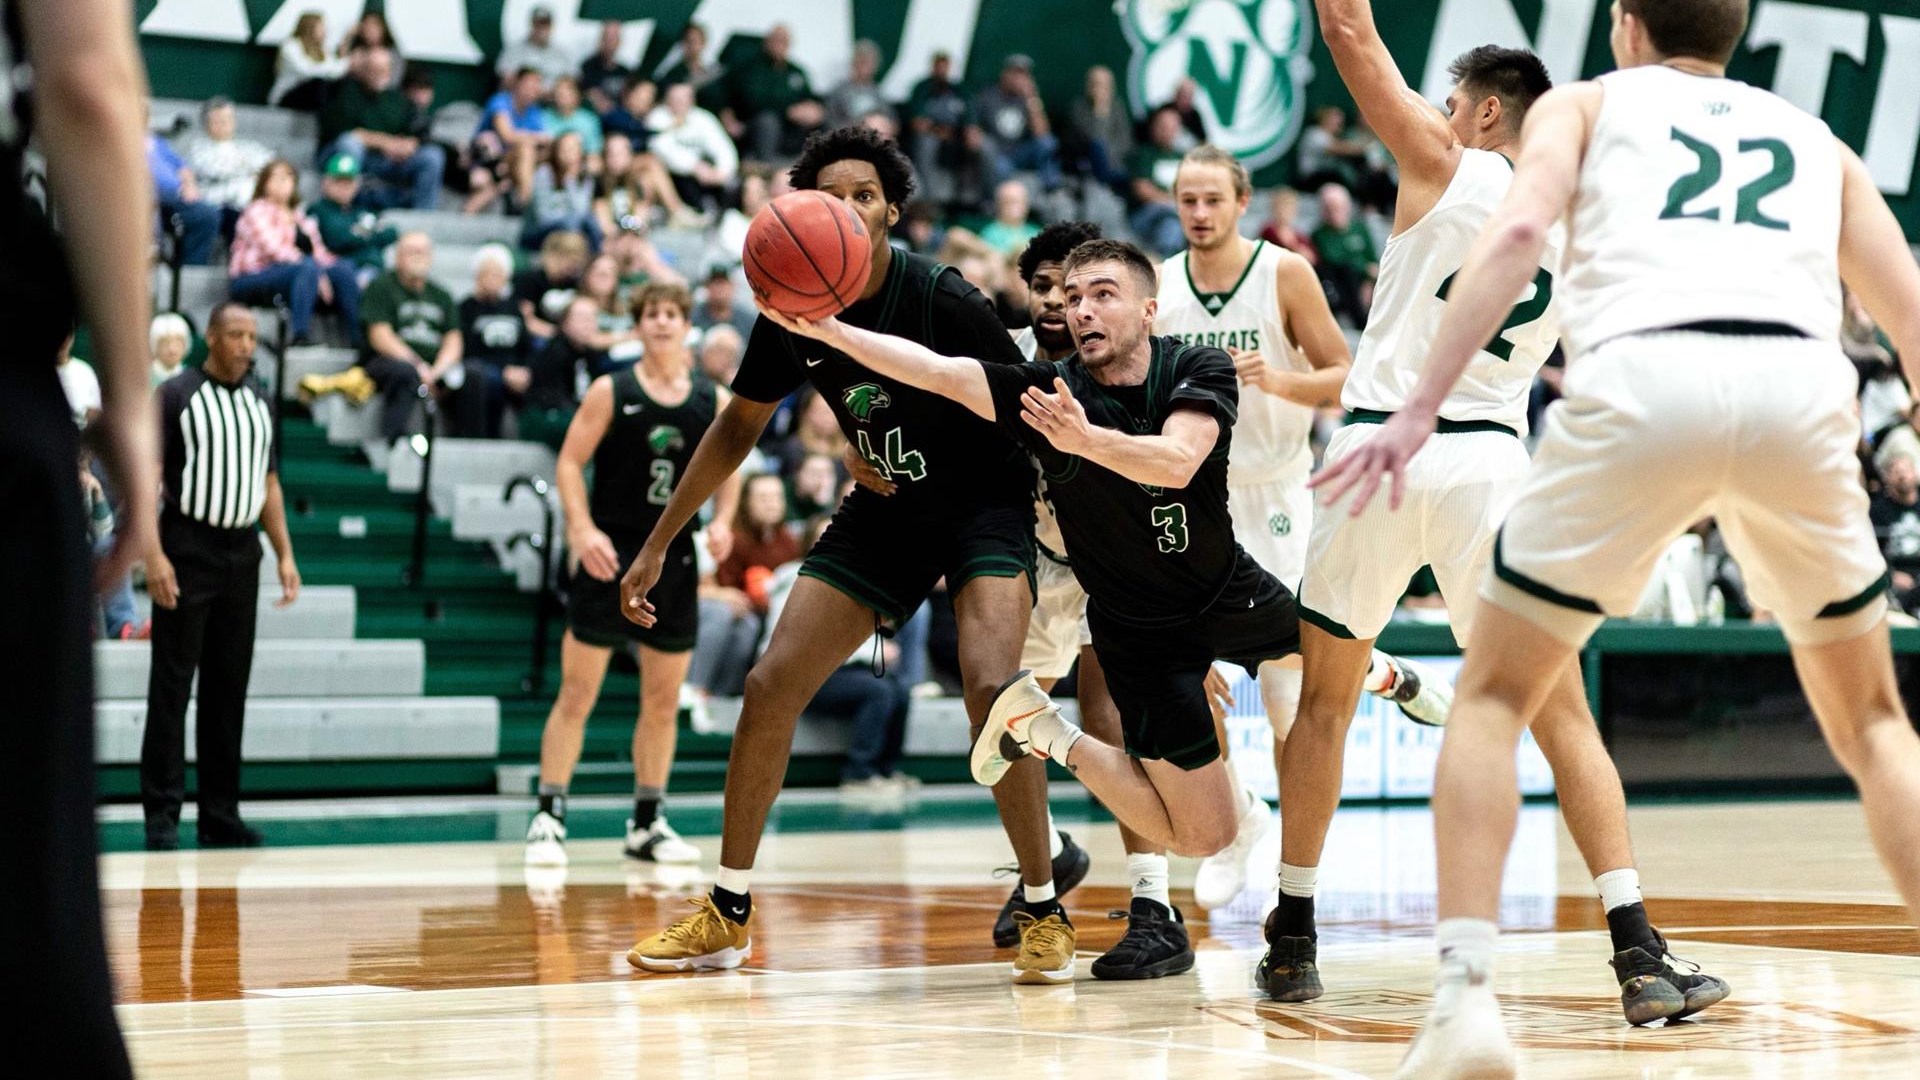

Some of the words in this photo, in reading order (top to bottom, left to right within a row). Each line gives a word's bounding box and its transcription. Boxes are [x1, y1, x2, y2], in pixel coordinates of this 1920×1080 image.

[1657, 125, 1796, 232] 22
[856, 426, 928, 481] 44
[647, 458, 675, 506] 2
[1150, 502, 1189, 553] 3
